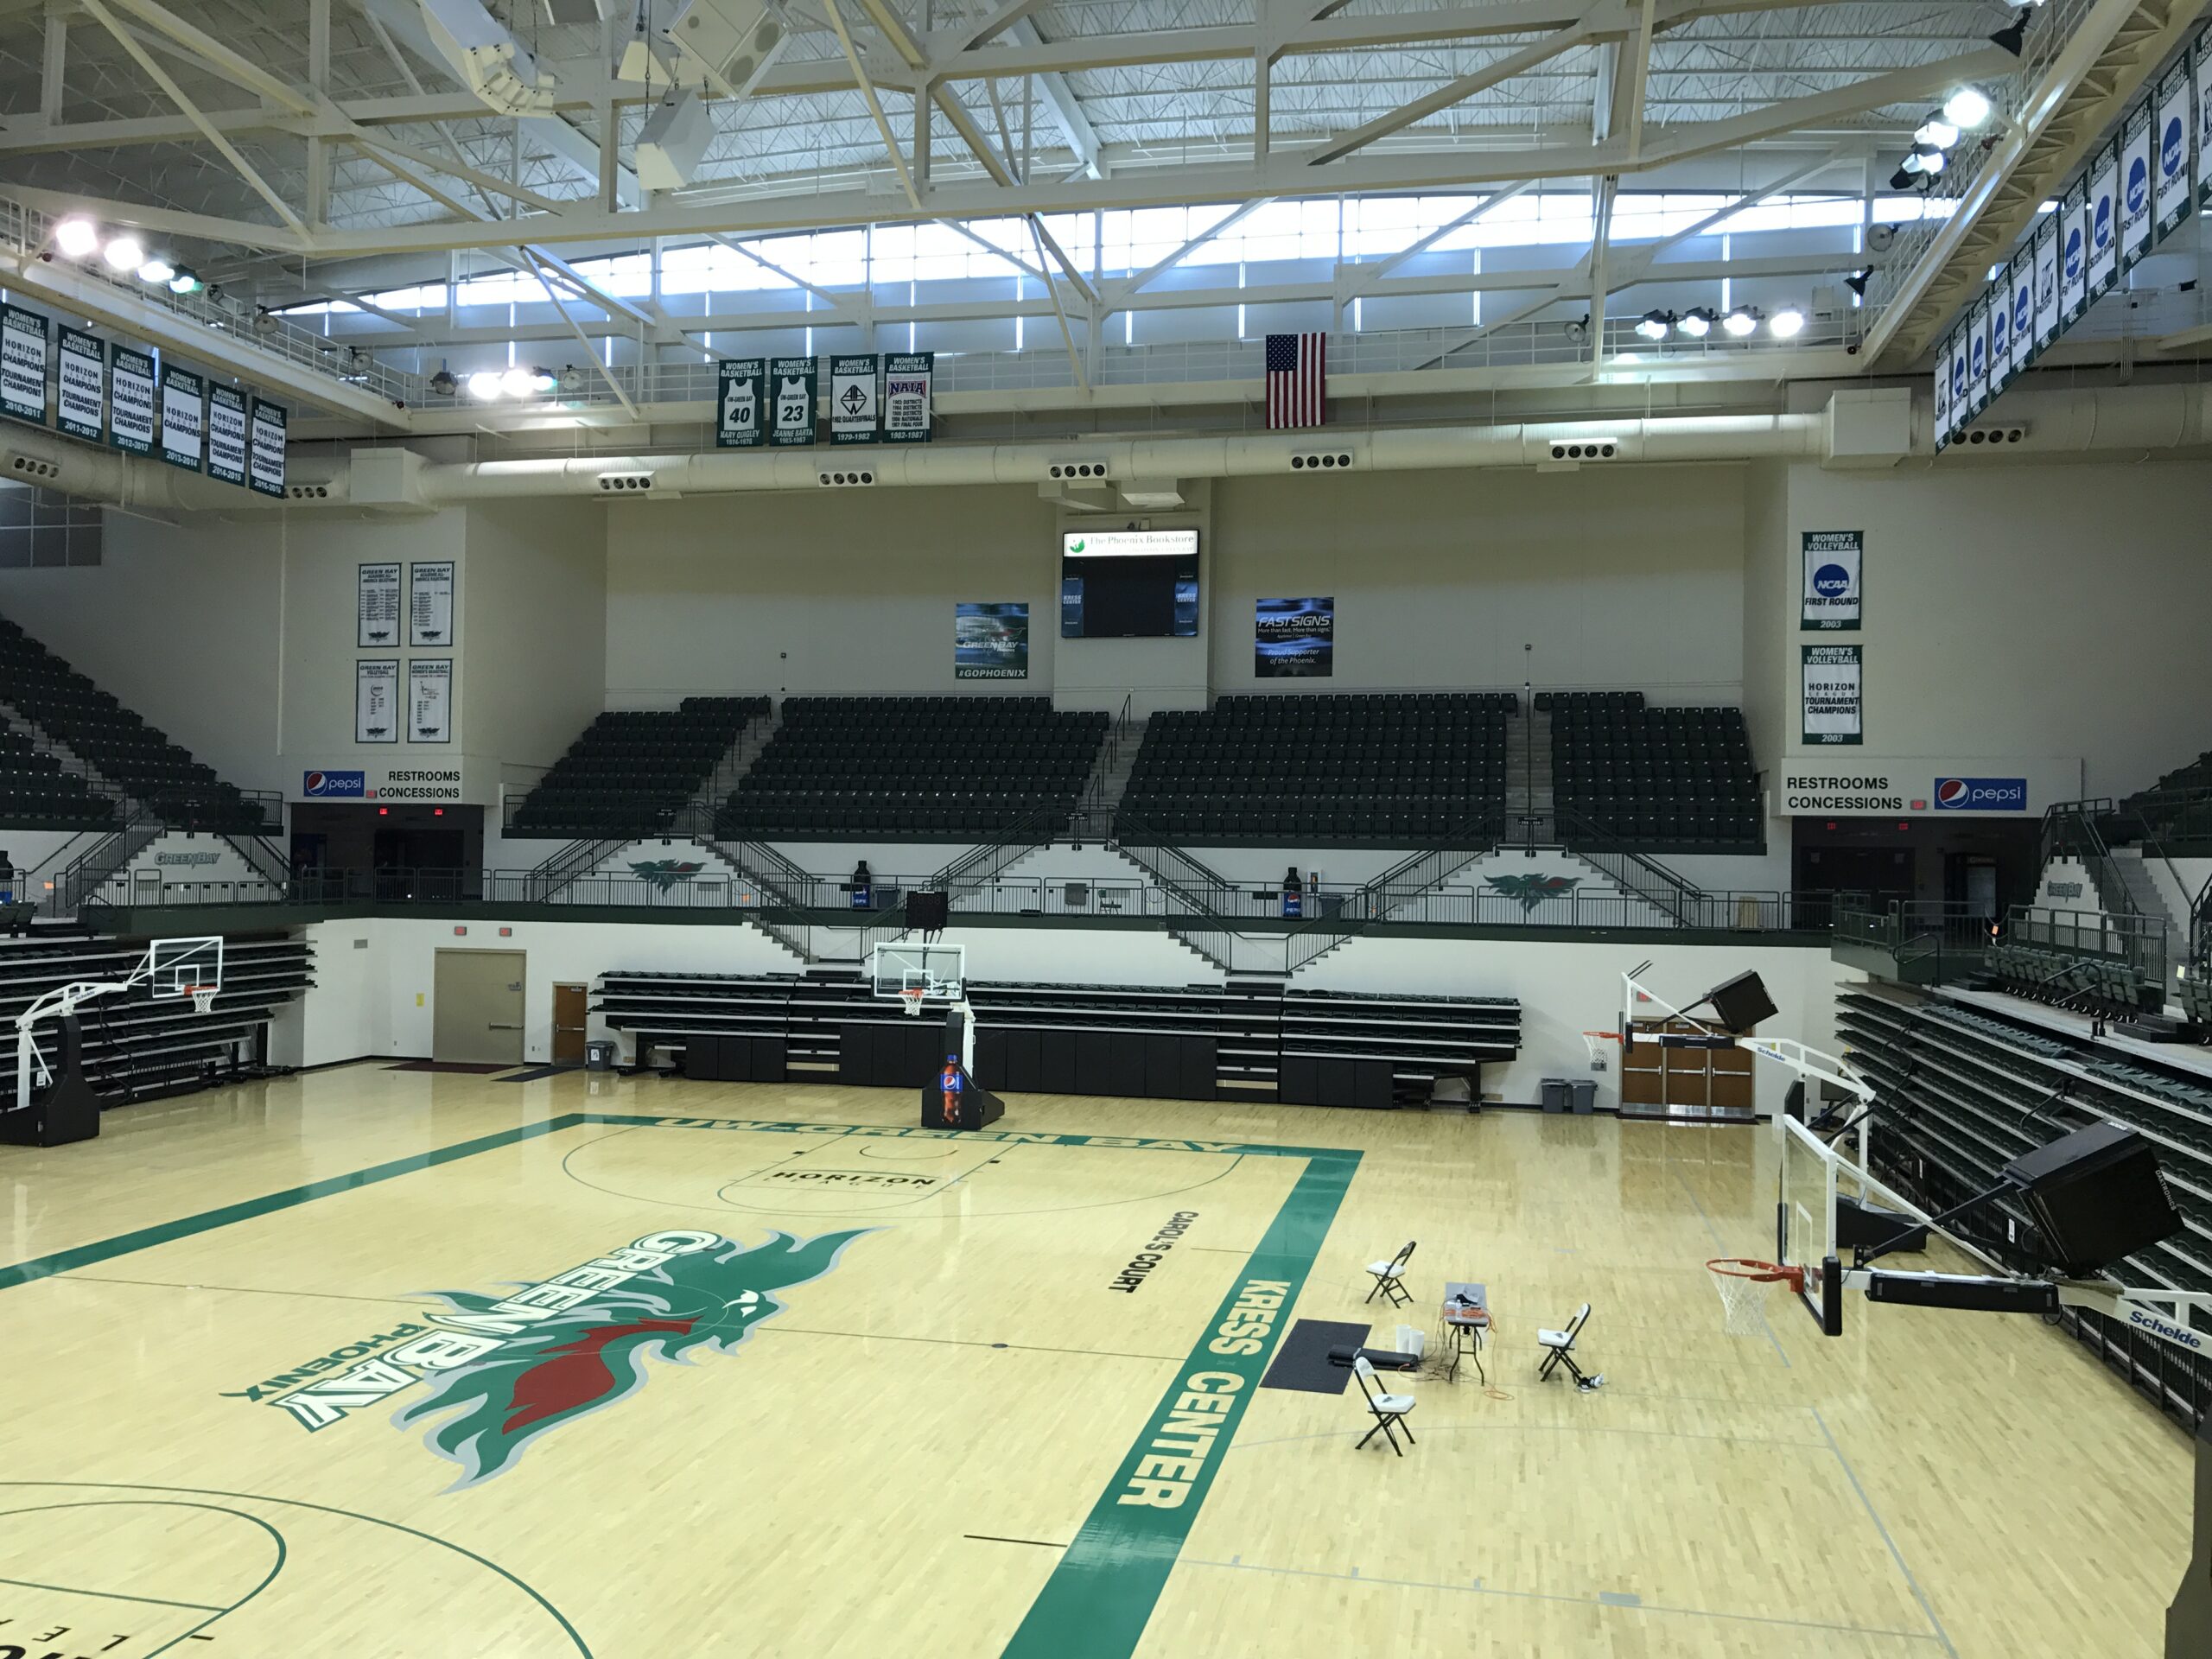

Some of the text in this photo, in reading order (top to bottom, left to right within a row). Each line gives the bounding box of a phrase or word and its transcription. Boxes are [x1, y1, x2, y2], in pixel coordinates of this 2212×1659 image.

[9, 309, 41, 327] WOMEN'S
[3, 316, 45, 338] BASKETBALL
[5, 339, 41, 358] HORIZON
[62, 339, 101, 359] BASKETBALL
[67, 332, 97, 350] WOMEN'S
[3, 353, 45, 373] CHAMPIONS
[120, 353, 148, 368] WOMEN'S
[726, 361, 759, 370] WOMEN'S
[778, 359, 811, 368] WOMEN'S
[838, 359, 870, 367] WOMEN'S
[65, 362, 98, 379] HORIZON
[721, 368, 762, 377] BASKETBALL
[773, 366, 815, 376] BASKETBALL
[835, 365, 874, 374] BASKETBALL
[63, 375, 101, 394] CHAMPIONS
[116, 377, 150, 395] HORIZON
[166, 377, 200, 395] BASKETBALL
[169, 370, 196, 386] WOMEN'S
[3, 379, 41, 397] CHAMPIONS
[889, 381, 925, 397] NAIA
[62, 389, 101, 409] TOURNAMENT
[64, 399, 99, 416] CHAMPIONS
[113, 406, 153, 425] TOURNAMENT
[166, 405, 199, 423] HORIZON
[729, 407, 750, 423] 40
[782, 405, 804, 422] 23
[213, 410, 243, 427] HORIZON
[164, 419, 200, 438] CHAMPIONS
[211, 423, 245, 442] CHAMPIONS
[211, 438, 245, 454] TOURNAMENT
[166, 450, 198, 467] 2013-2014
[213, 448, 243, 464] CHAMPIONS
[1090, 534, 1193, 545] The Phoenix Bookstore
[1812, 533, 1854, 542] WOMEN'S
[1808, 542, 1859, 550] VOLLEYBALL
[1816, 580, 1849, 589] NCAA
[1805, 597, 1859, 606] FIRST ROUND
[1258, 615, 1331, 627] FASTSIGNS
[963, 641, 998, 651] GREEN
[1811, 647, 1853, 656] WOMEN'S
[1807, 656, 1859, 664] VOLLEYBALL
[1808, 683, 1855, 691] HORIZON
[1808, 706, 1857, 715] CHAMPIONS
[328, 778, 361, 791] pepsi
[388, 771, 461, 782] RESTROOMS
[1787, 778, 1889, 790] RESTROOMS
[379, 787, 460, 798] CONCESSIONS
[1972, 786, 2021, 801] pepsi
[1788, 796, 1903, 810] CONCESSIONS
[155, 852, 221, 869] GREEN BAY
[655, 1117, 1246, 1152] UW-GREEN BAY
[763, 1177, 925, 1190] LEAGUE
[772, 1172, 937, 1186] HORIZON
[2155, 1169, 2177, 1211] DAKTRONICS
[1108, 1211, 1199, 1294] CAROL'S COURT
[267, 1229, 723, 1433] GREEN BAY
[2130, 1311, 2201, 1348] Schelde
[219, 1323, 430, 1402] PHOENIX
[1116, 1279, 1292, 1510] KRESS CENTER
